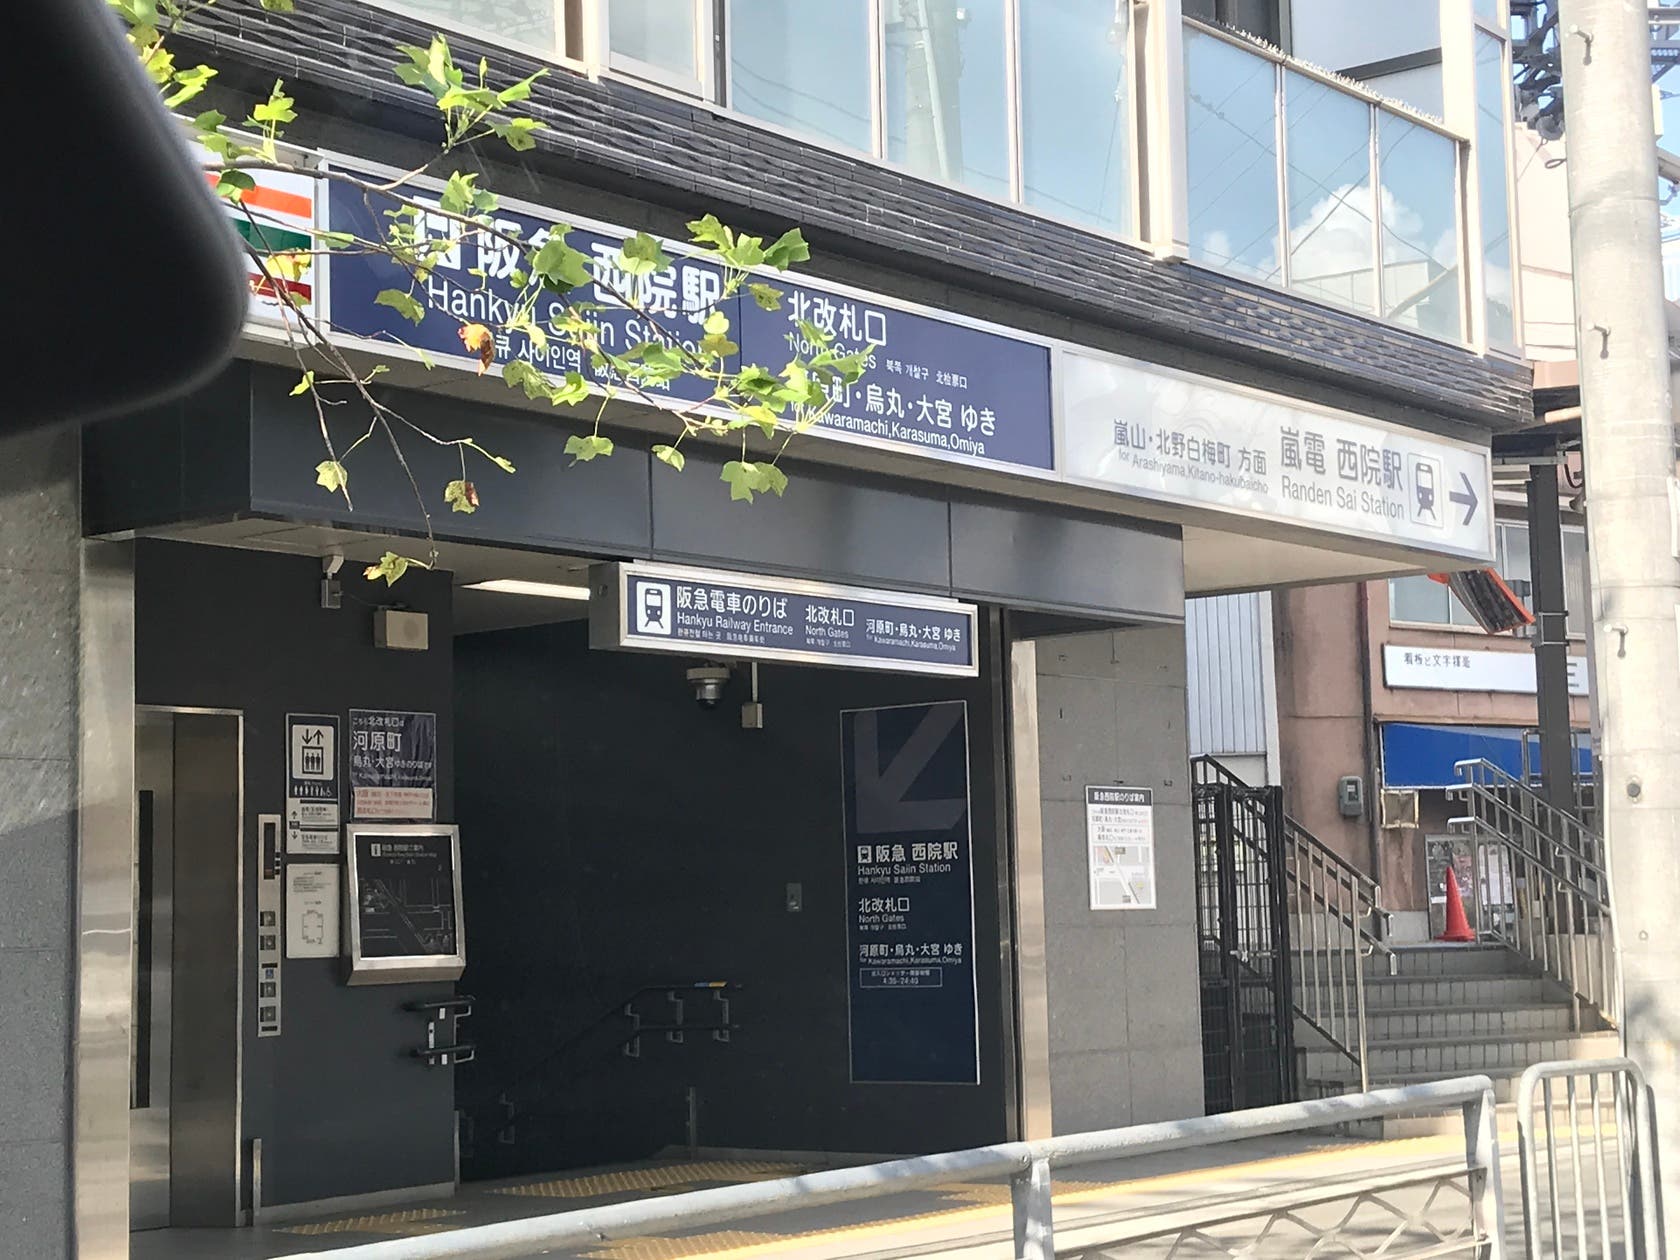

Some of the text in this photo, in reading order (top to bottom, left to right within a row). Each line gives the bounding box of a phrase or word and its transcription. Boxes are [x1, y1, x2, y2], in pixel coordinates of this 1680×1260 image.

[787, 290, 887, 347] 北改札口
[961, 403, 996, 437] ゆき
[1238, 446, 1268, 476] 方面
[1280, 425, 1404, 492] 嵐電 西院駅
[1281, 474, 1405, 520] Randen Sai Station
[676, 585, 789, 619] 阪急電車のりば
[677, 612, 794, 636] Hankyu Railway Entrance
[805, 604, 855, 627] 北改札口
[805, 624, 850, 640] North Gates
[944, 627, 961, 642] ゆき
[352, 730, 402, 752] 河原町
[875, 841, 958, 863] 阪急 西院駅
[857, 865, 891, 878] Hankyu
[918, 862, 951, 874] Station
[858, 897, 910, 913] 北改札口
[943, 943, 962, 956] ゆき
